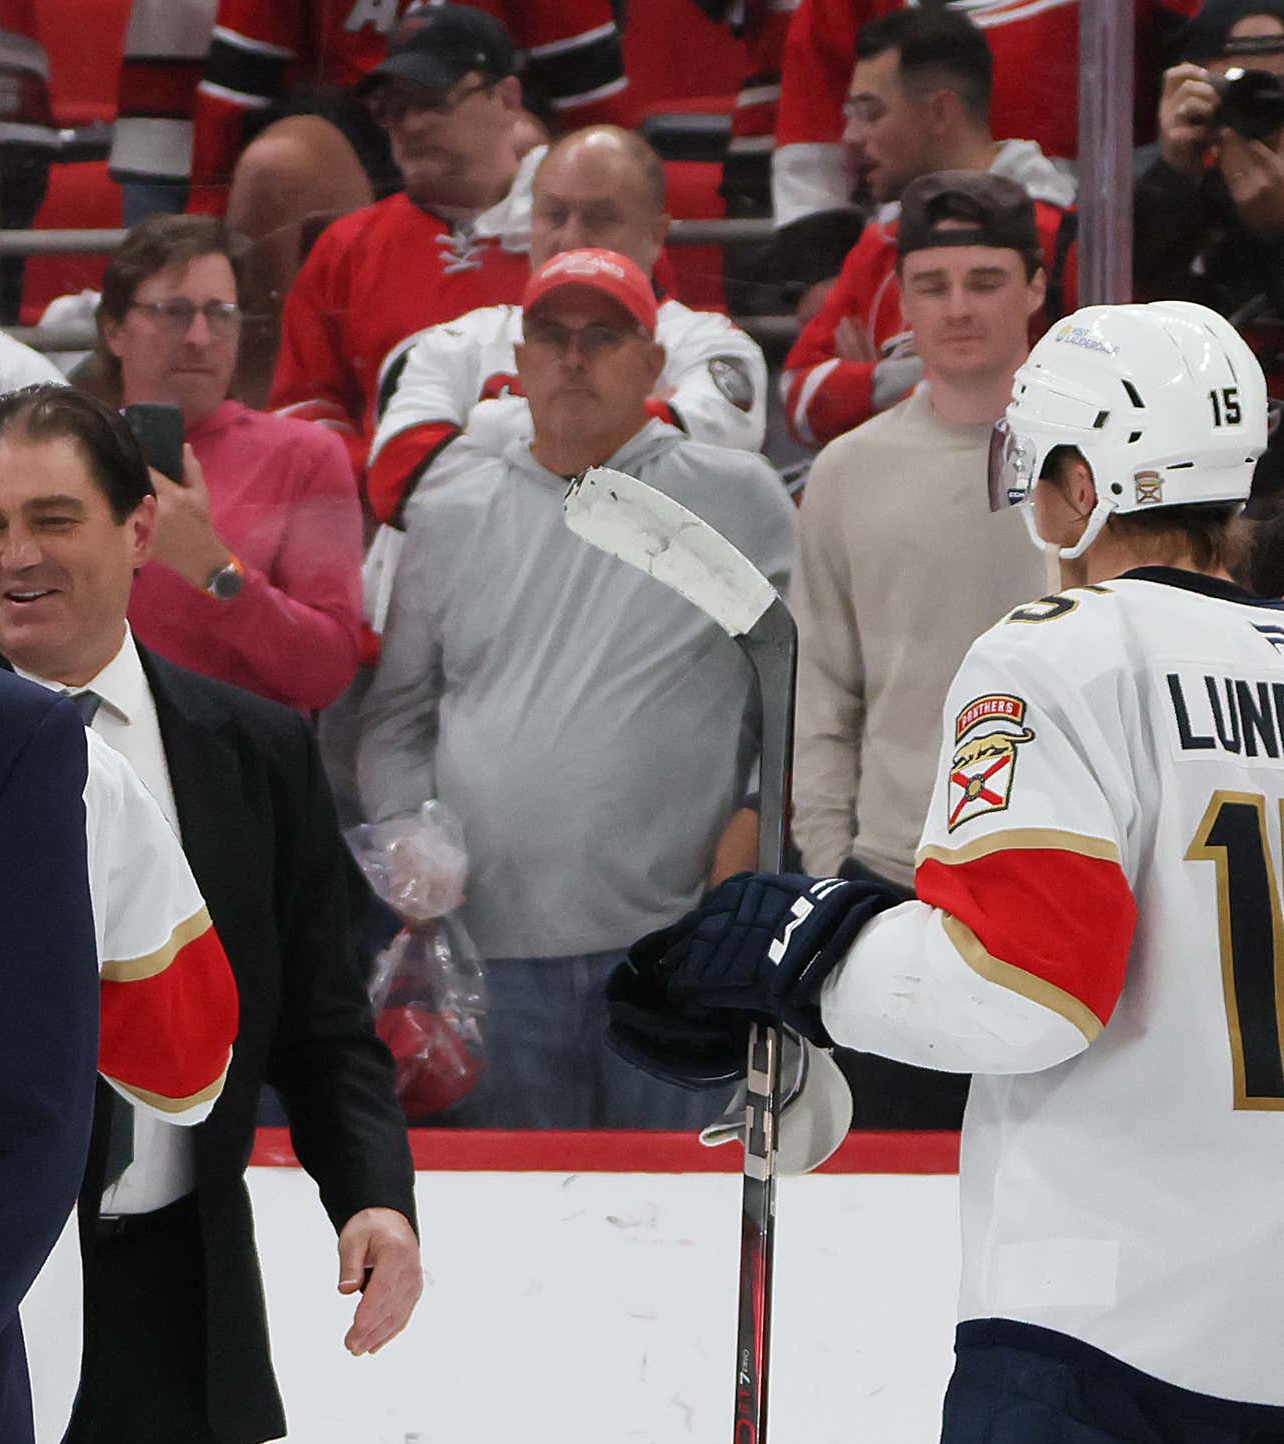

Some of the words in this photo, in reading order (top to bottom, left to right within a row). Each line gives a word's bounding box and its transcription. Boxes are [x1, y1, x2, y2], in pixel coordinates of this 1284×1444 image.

[1209, 387, 1243, 428] 15
[960, 699, 1015, 728] PANTHERS
[1165, 673, 1284, 759] LUN
[1183, 789, 1284, 1111] 1
